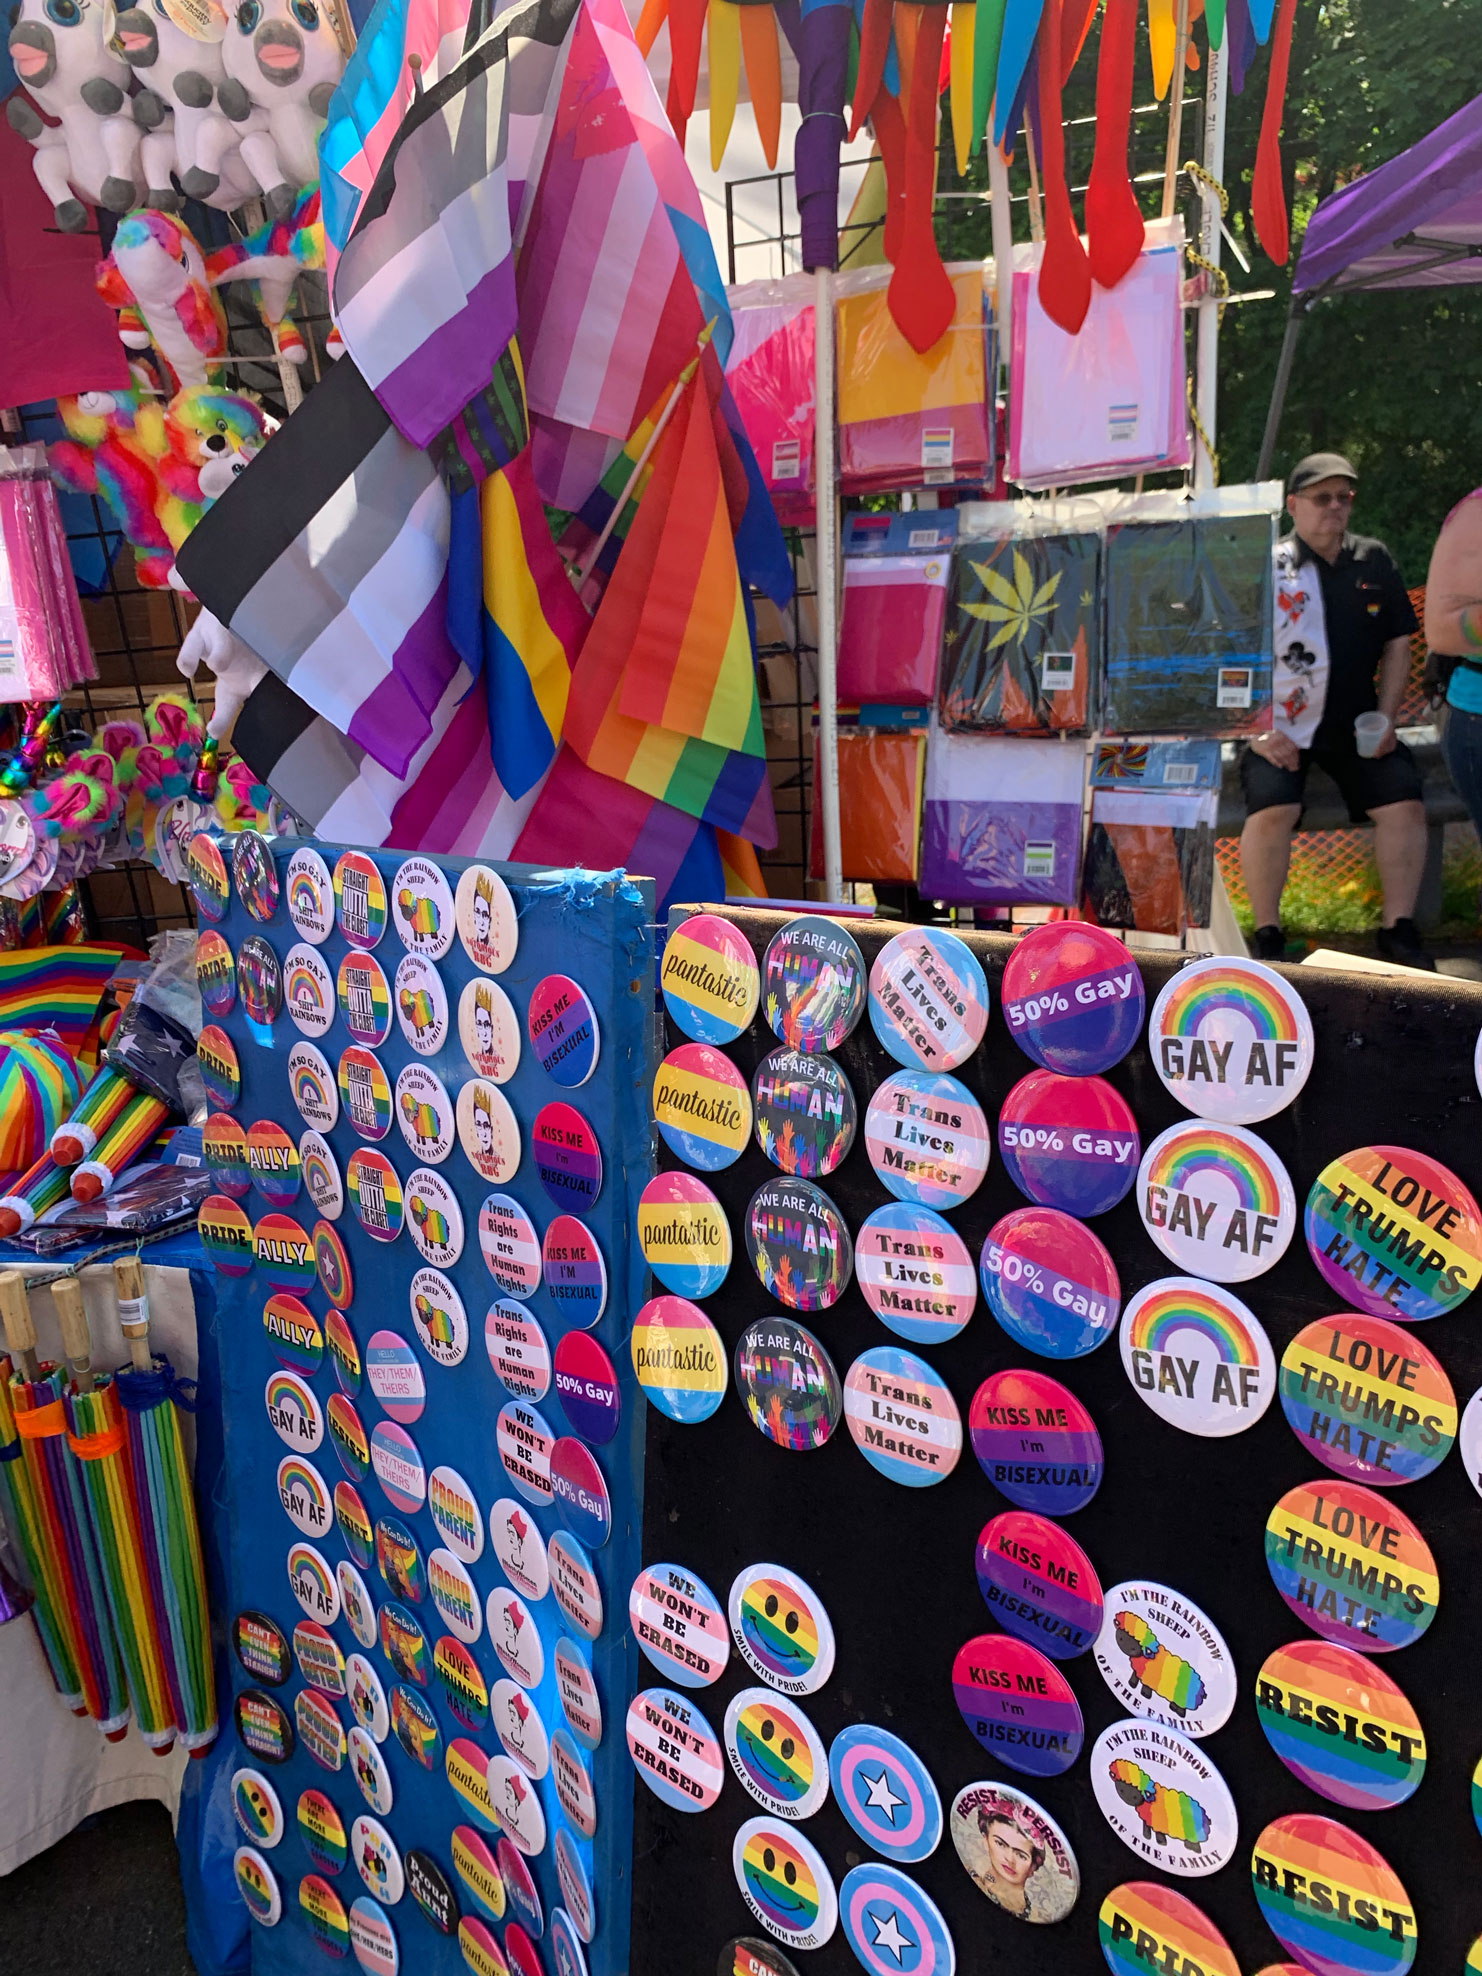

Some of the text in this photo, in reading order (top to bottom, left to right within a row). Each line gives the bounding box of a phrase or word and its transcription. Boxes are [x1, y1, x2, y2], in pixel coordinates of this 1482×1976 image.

[343, 868, 369, 892] STRAIGHT
[343, 887, 369, 919] OUTTA
[351, 916, 369, 939] CLOSET
[781, 931, 849, 960] WE ARE ALL
[295, 957, 305, 966] SO
[306, 959, 327, 981] GAY
[473, 950, 492, 968] RBG
[768, 950, 854, 998] HUMAN
[663, 952, 747, 1008] pantastic
[915, 944, 967, 1018] Trans
[290, 1007, 327, 1026] RAINBOWS
[298, 1001, 313, 1012] SHIT
[532, 994, 571, 1036] KISS ME
[901, 969, 947, 1032] Lives
[1009, 972, 1133, 1027] 50% Gay
[548, 1021, 565, 1042] I'M
[878, 981, 937, 1059] Matter
[200, 1046, 232, 1084] PRIDE
[542, 1026, 590, 1072] BISEXUAL
[1161, 1038, 1298, 1087] GAY AF
[768, 1057, 838, 1087] WE ARE ALL
[656, 1083, 742, 1130] pantastic
[757, 1074, 843, 1123] HUMAN
[893, 1092, 962, 1129] Trans
[205, 1142, 246, 1163] PRIDE
[894, 1120, 955, 1155] Lives
[1004, 1126, 1134, 1163] 50% Gay
[250, 1146, 290, 1171] ALLY
[882, 1146, 962, 1188] Matter
[488, 1200, 514, 1219] Trans
[760, 1192, 830, 1223] WE ARE ALL
[1370, 1161, 1463, 1240] LOVE
[201, 1223, 247, 1247] PRIDE
[488, 1218, 518, 1239] Rights
[644, 1218, 721, 1254] pantastic
[752, 1209, 838, 1258] HUMAN
[1146, 1185, 1278, 1257] GAY AF
[1330, 1183, 1468, 1296] TRUMPS
[257, 1238, 308, 1266] ALLY
[497, 1242, 514, 1254] are
[547, 1247, 587, 1260] KISS ME
[876, 1233, 945, 1260] Trans
[491, 1255, 526, 1276] Human
[496, 1273, 527, 1294] Rights
[560, 1265, 575, 1279] I'M
[884, 1260, 944, 1286] Lives
[1324, 1232, 1412, 1308] HATE
[550, 1285, 598, 1299] BISEXUAL
[879, 1288, 957, 1318] Matter
[986, 1246, 1107, 1328] 50% Gay
[267, 1313, 314, 1350] ALLY
[745, 1333, 815, 1360] WE ARE ALL
[637, 1344, 716, 1376] pantastic
[740, 1351, 826, 1397] HUMAN
[1131, 1348, 1260, 1408] GAY AF
[1329, 1330, 1420, 1392] LOVE
[380, 1383, 410, 1395] THEIRS
[556, 1373, 614, 1407] 50% Gay
[866, 1372, 933, 1410] Trans
[1300, 1362, 1444, 1446] TRUMPS
[269, 1405, 316, 1440] GAY AF
[515, 1408, 534, 1429] WE
[871, 1400, 930, 1435] Lives
[987, 1406, 1069, 1428] KISS ME
[505, 1419, 545, 1453] WON'T
[516, 1444, 532, 1463] BE
[864, 1425, 940, 1466] Matter
[1020, 1438, 1045, 1454] I'm
[1309, 1411, 1397, 1473] HATE
[504, 1454, 551, 1493] ERASED
[994, 1463, 1095, 1488] BISEXUAL
[280, 1487, 325, 1526] GAY AF
[431, 1475, 474, 1529] PROUD
[432, 1501, 476, 1550] PARENT
[1312, 1496, 1402, 1560] LOVE
[999, 1535, 1079, 1590] KISS ME
[1285, 1526, 1426, 1615] TRUMPS
[668, 1571, 697, 1600] WE
[1023, 1578, 1046, 1600] I'm
[649, 1582, 710, 1629] WON'T
[987, 1585, 1084, 1649] BISEXUAL
[1148, 1608, 1191, 1640] SHEEP
[1296, 1576, 1382, 1639] HATE
[662, 1612, 687, 1639] BE
[1120, 1589, 1224, 1663] I'M THE RAINBOW
[442, 1646, 470, 1681] LOVE
[638, 1620, 711, 1675] ERASED
[733, 1628, 809, 1693] SMILE WITH PRIDE!
[437, 1662, 482, 1711] TRUMPS
[969, 1665, 1049, 1695] KISS ME
[1096, 1653, 1206, 1733] OF THE FAMILY
[447, 1692, 473, 1724] HATE
[664, 1697, 692, 1726] WE
[1001, 1701, 1025, 1716] I'm
[1258, 1678, 1422, 1767] RESIST
[645, 1705, 705, 1756] WON'T
[976, 1720, 1073, 1755] BISEXUAL
[658, 1736, 681, 1763] BE
[1105, 1729, 1213, 1781] I'M THE RAINBOW
[1133, 1747, 1177, 1770] SHEEP
[634, 1741, 704, 1800] ERASED
[729, 1746, 801, 1817] SMILE WITH PRIDE!
[956, 1788, 1073, 1880] RESIST PERSIST
[1108, 1814, 1224, 1869] OF THE FAMILY
[410, 1855, 449, 1910] Proud
[453, 1847, 499, 1904] pantastic
[410, 1875, 449, 1926] Aunt
[1254, 1854, 1414, 1944] RESIST
[742, 1890, 819, 1947] SMILE WITH PRIDE!
[1111, 1912, 1216, 1976] PRID
